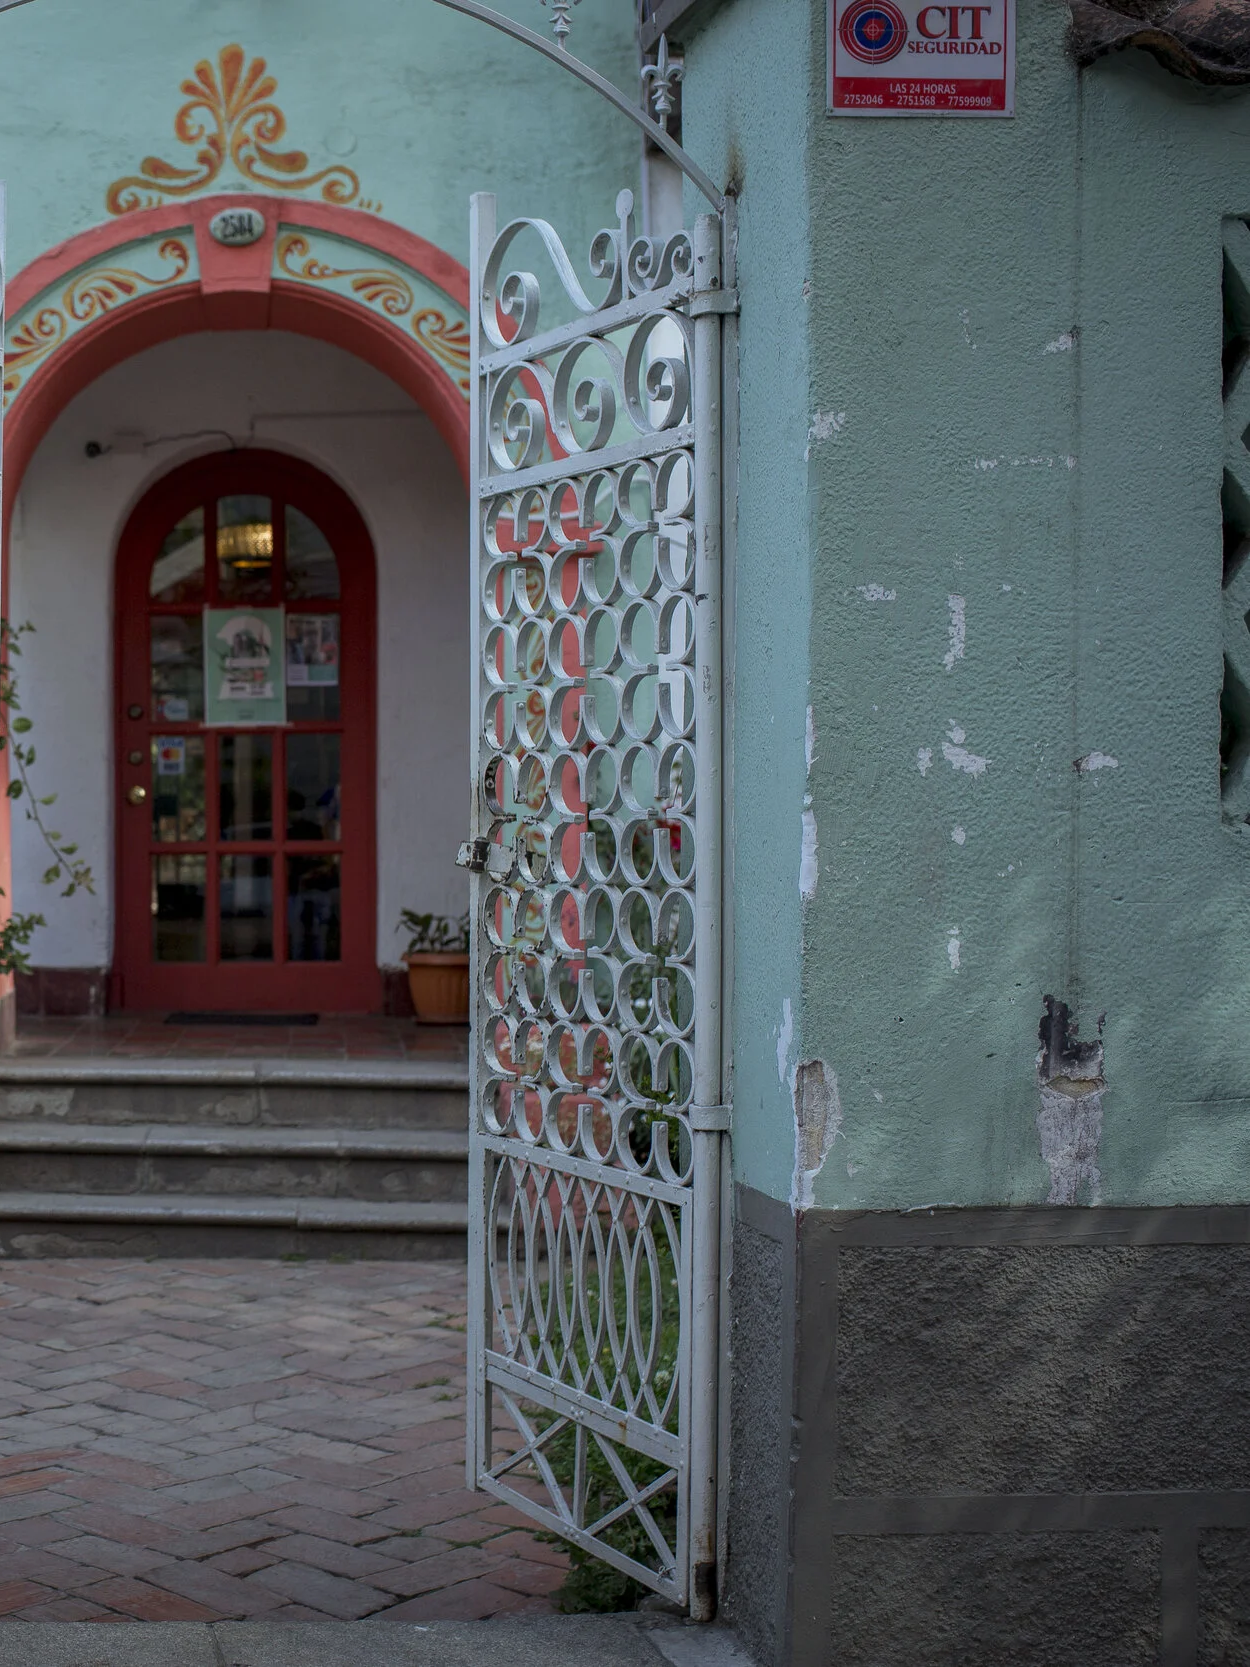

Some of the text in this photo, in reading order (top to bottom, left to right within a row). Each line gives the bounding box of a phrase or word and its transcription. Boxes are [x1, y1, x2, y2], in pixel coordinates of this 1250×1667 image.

[916, 5, 991, 41] CIT
[907, 41, 1002, 55] SEGURIDAD
[889, 82, 956, 95] LAS 24 HORAS
[843, 94, 884, 105] 2752046
[896, 95, 936, 106] 2751568
[947, 96, 992, 107] 77599909
